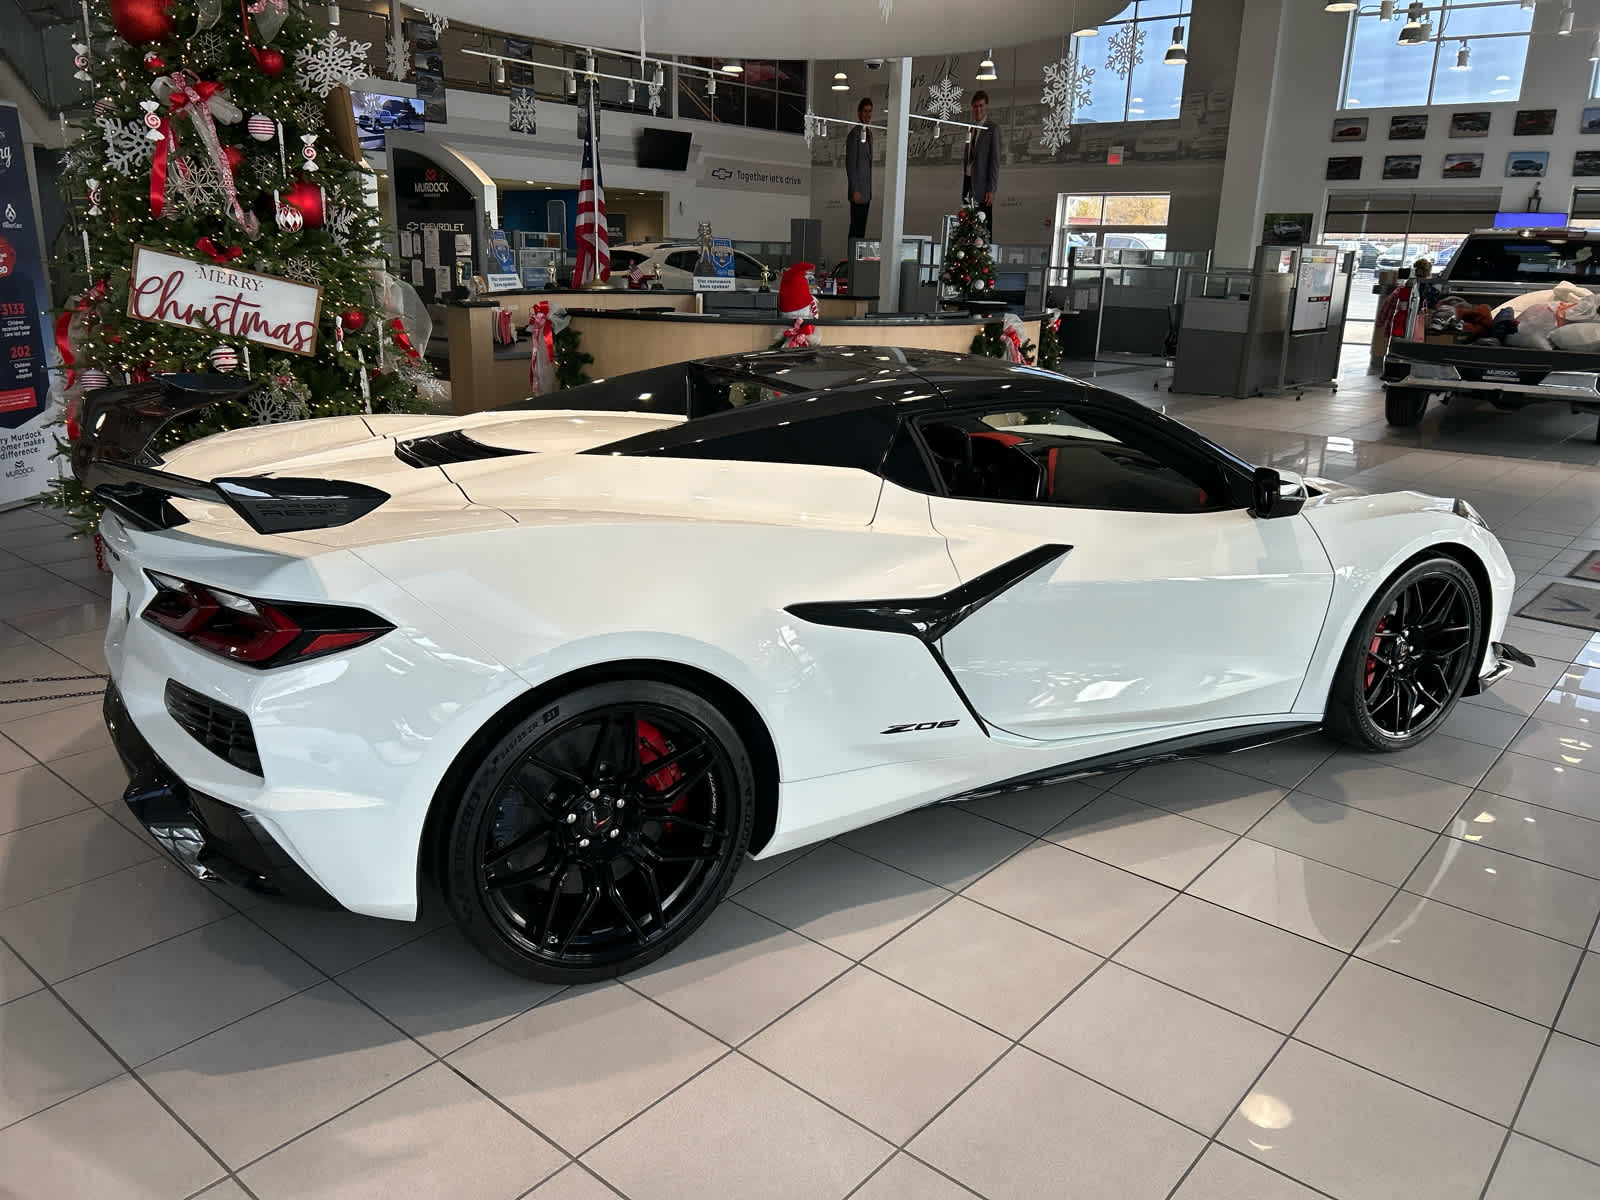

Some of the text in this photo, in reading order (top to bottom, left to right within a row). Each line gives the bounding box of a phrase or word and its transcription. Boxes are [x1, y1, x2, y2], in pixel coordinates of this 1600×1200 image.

[737, 170, 768, 183] Together
[769, 173, 784, 183] let's
[414, 182, 449, 193] MURDOCK
[419, 222, 465, 232] CHEVROLET
[199, 266, 260, 292] MERRY
[131, 271, 316, 350] Christmas
[10, 345, 32, 359] 202
[11, 431, 42, 442] Murdock
[23, 438, 45, 447] makes
[879, 719, 960, 734] Z06
